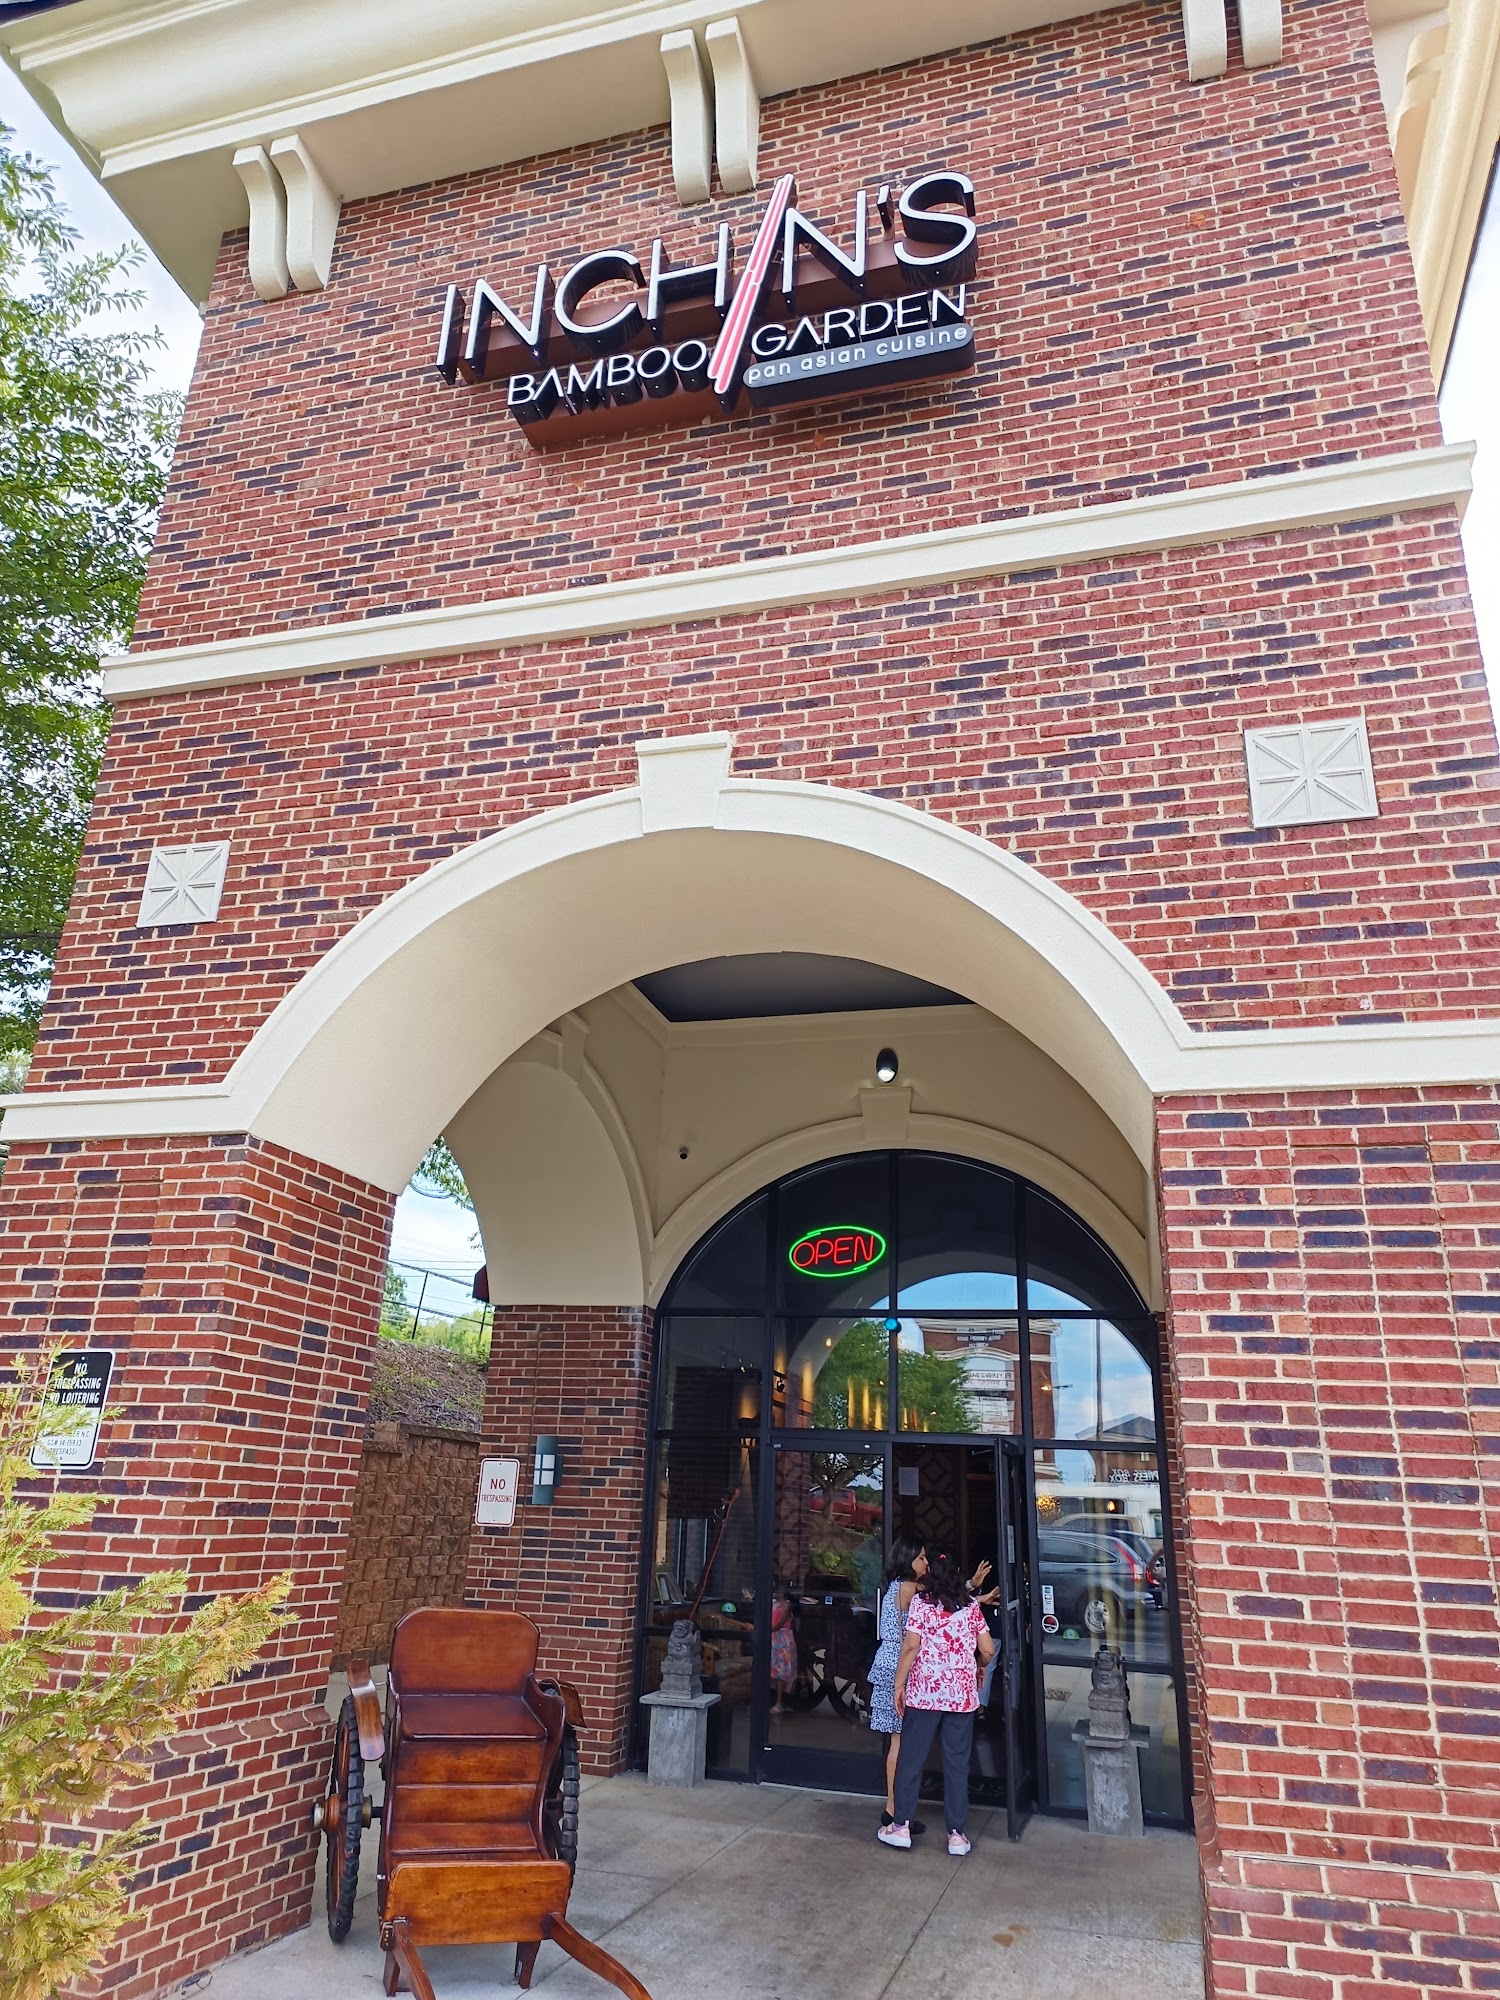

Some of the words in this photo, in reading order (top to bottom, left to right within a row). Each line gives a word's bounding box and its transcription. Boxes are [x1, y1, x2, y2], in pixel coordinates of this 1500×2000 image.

[436, 171, 977, 394] INCHIN'S
[507, 340, 707, 405] BAMBOO
[751, 284, 966, 356] GARDEN
[748, 362, 792, 386] pan
[801, 347, 866, 372] asian
[876, 325, 968, 356] cuisine
[793, 1235, 875, 1267] OPEN
[74, 1362, 88, 1375] NO
[61, 1392, 100, 1404] LOITERING
[490, 1478, 506, 1490] NO
